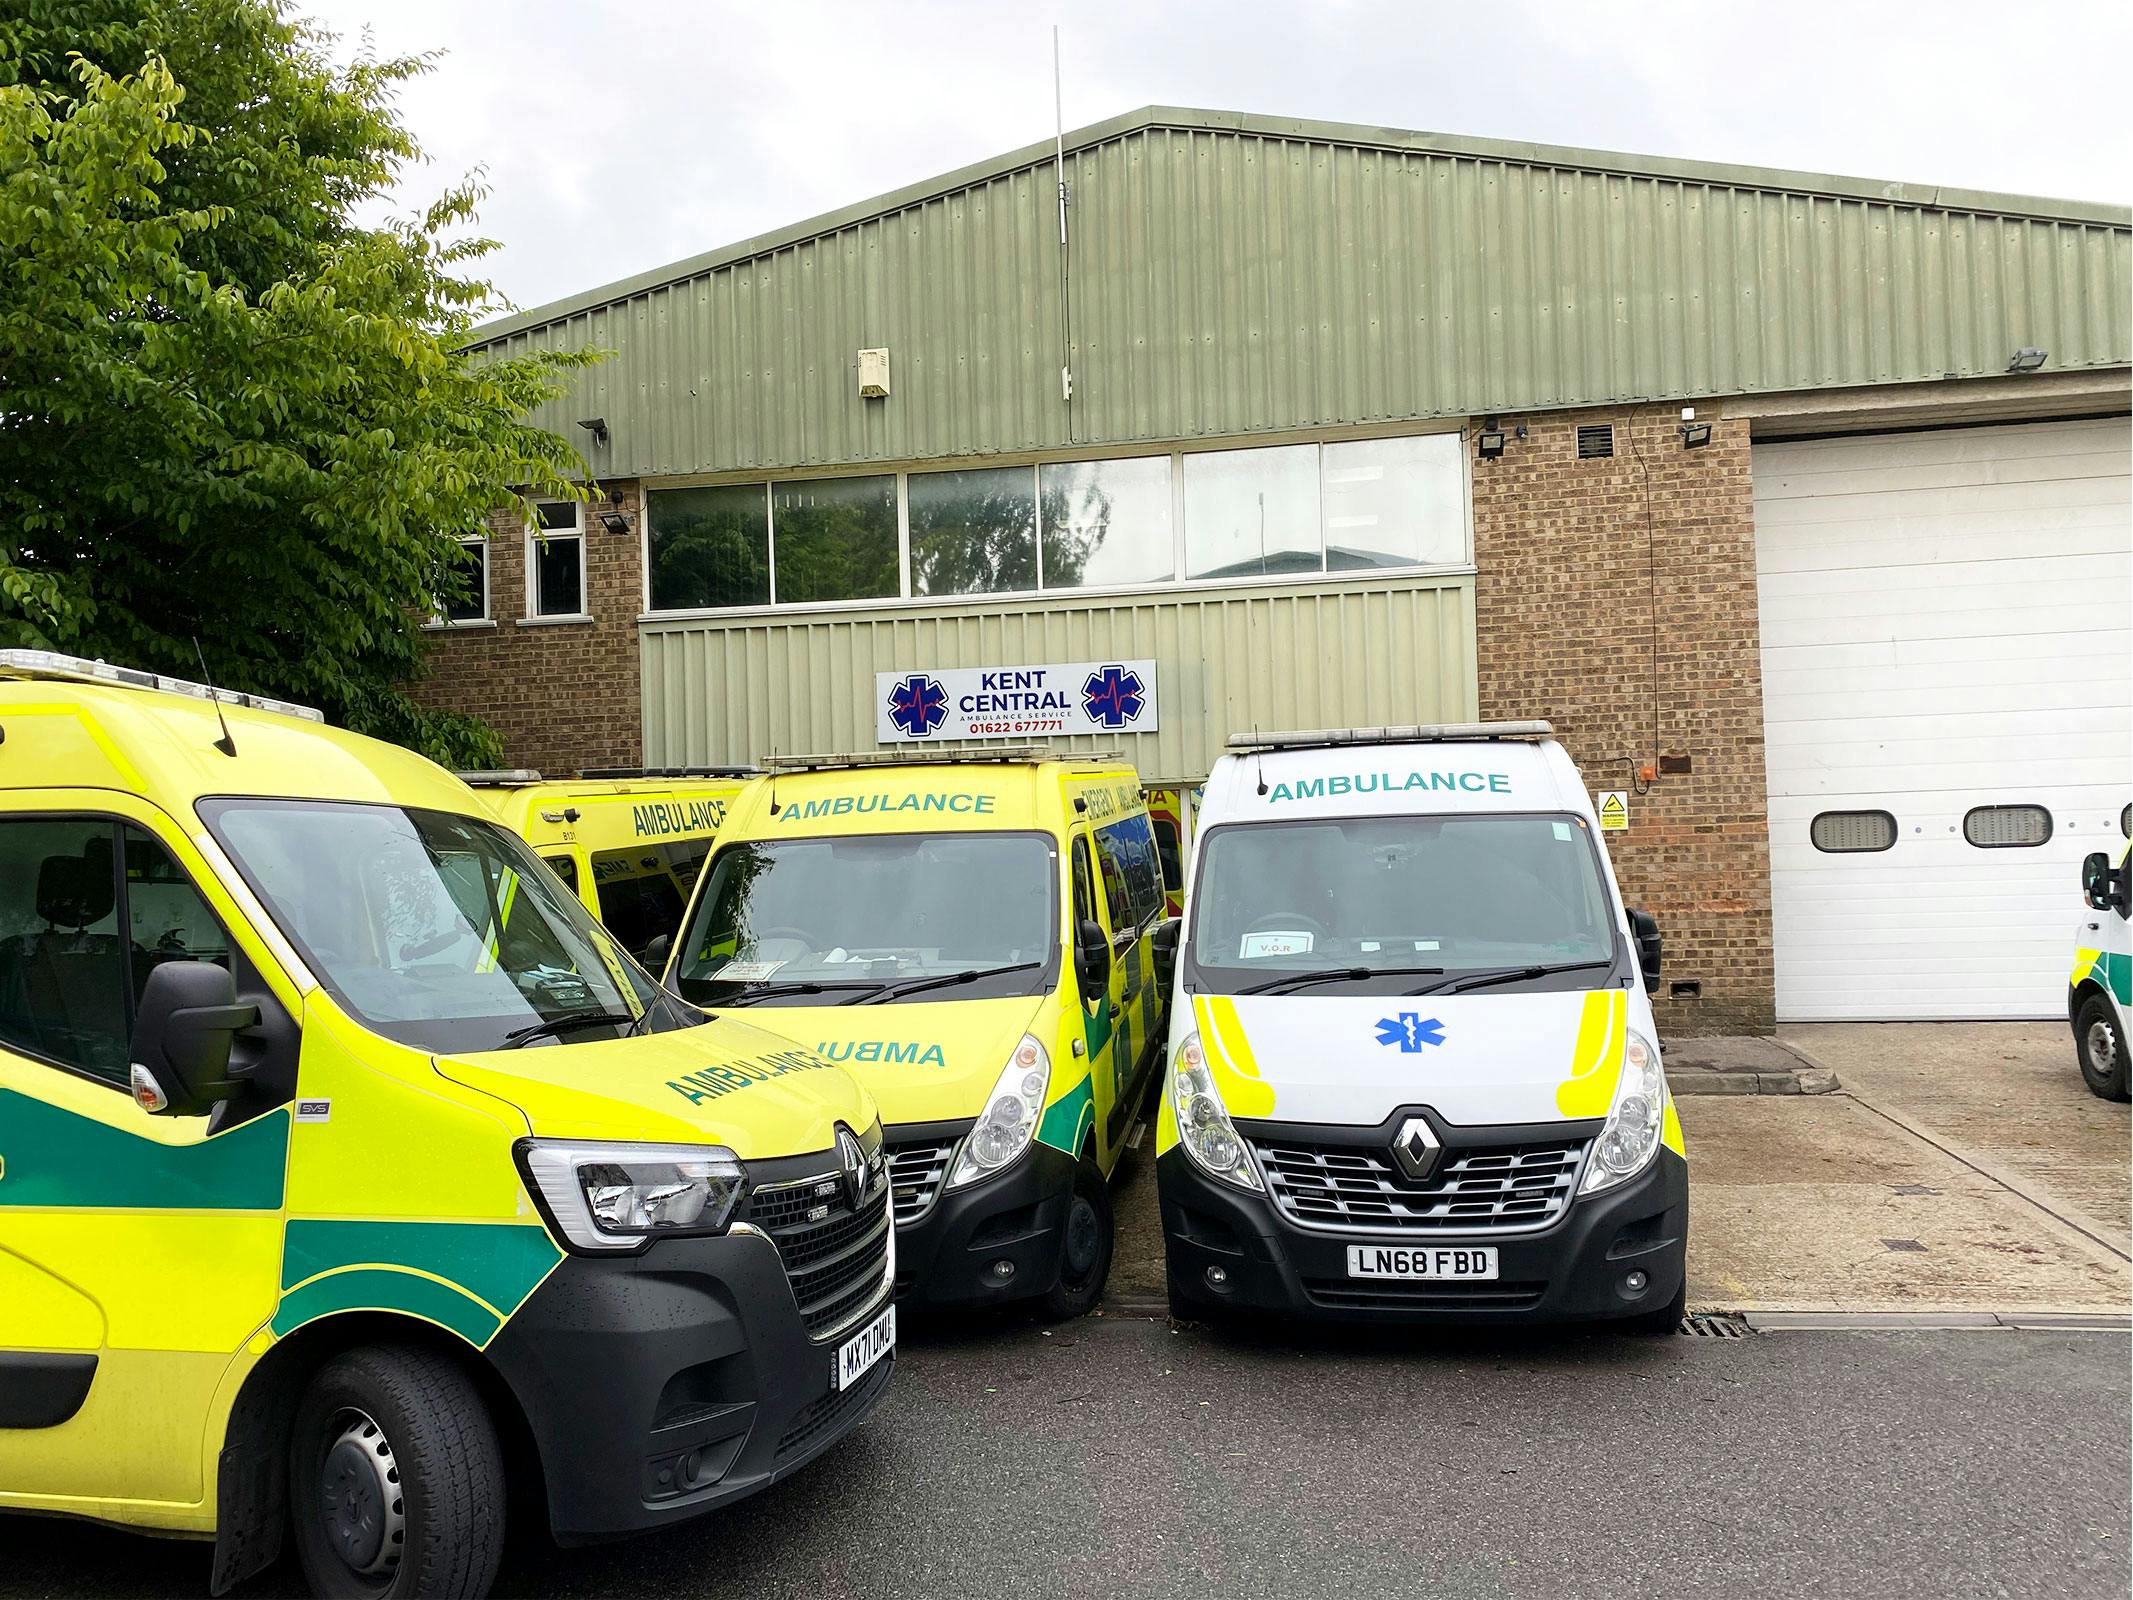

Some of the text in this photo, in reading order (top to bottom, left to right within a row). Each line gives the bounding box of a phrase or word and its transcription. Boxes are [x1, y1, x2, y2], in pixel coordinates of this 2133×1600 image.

[982, 670, 1046, 691] KENT
[959, 691, 1071, 712] CENTRAL
[1028, 711, 1072, 719] SERVICE
[970, 720, 1063, 734] 01622 677771
[1269, 772, 1512, 803] AMBULANCE
[779, 793, 996, 823] AMBULANCE
[1260, 944, 1291, 952] V.O.R
[665, 1050, 834, 1106] AMBULANCE
[302, 1104, 326, 1113] SVS
[1358, 1249, 1487, 1274] LN68 FBD
[846, 1313, 891, 1379] MX71 DMU
